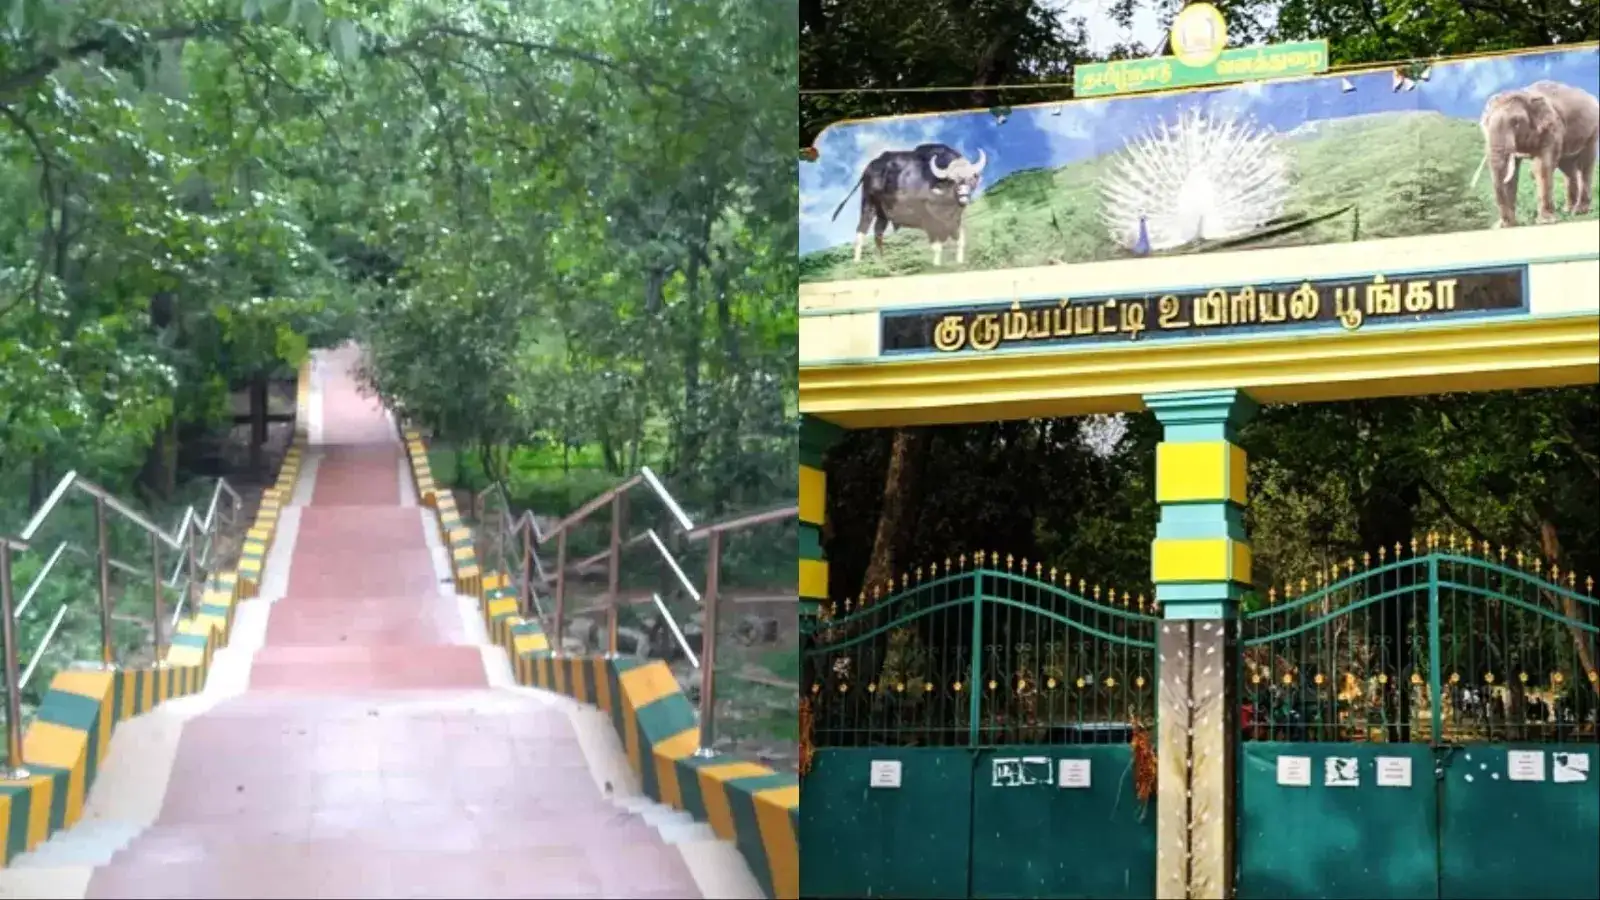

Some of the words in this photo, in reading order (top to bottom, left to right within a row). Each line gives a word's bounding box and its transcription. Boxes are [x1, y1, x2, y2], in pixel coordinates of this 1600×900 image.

[933, 298, 1146, 352] குரும்பப்பட்டி
[1157, 282, 1320, 329] உயிரியல்
[1334, 274, 1458, 330] பூங்கா
